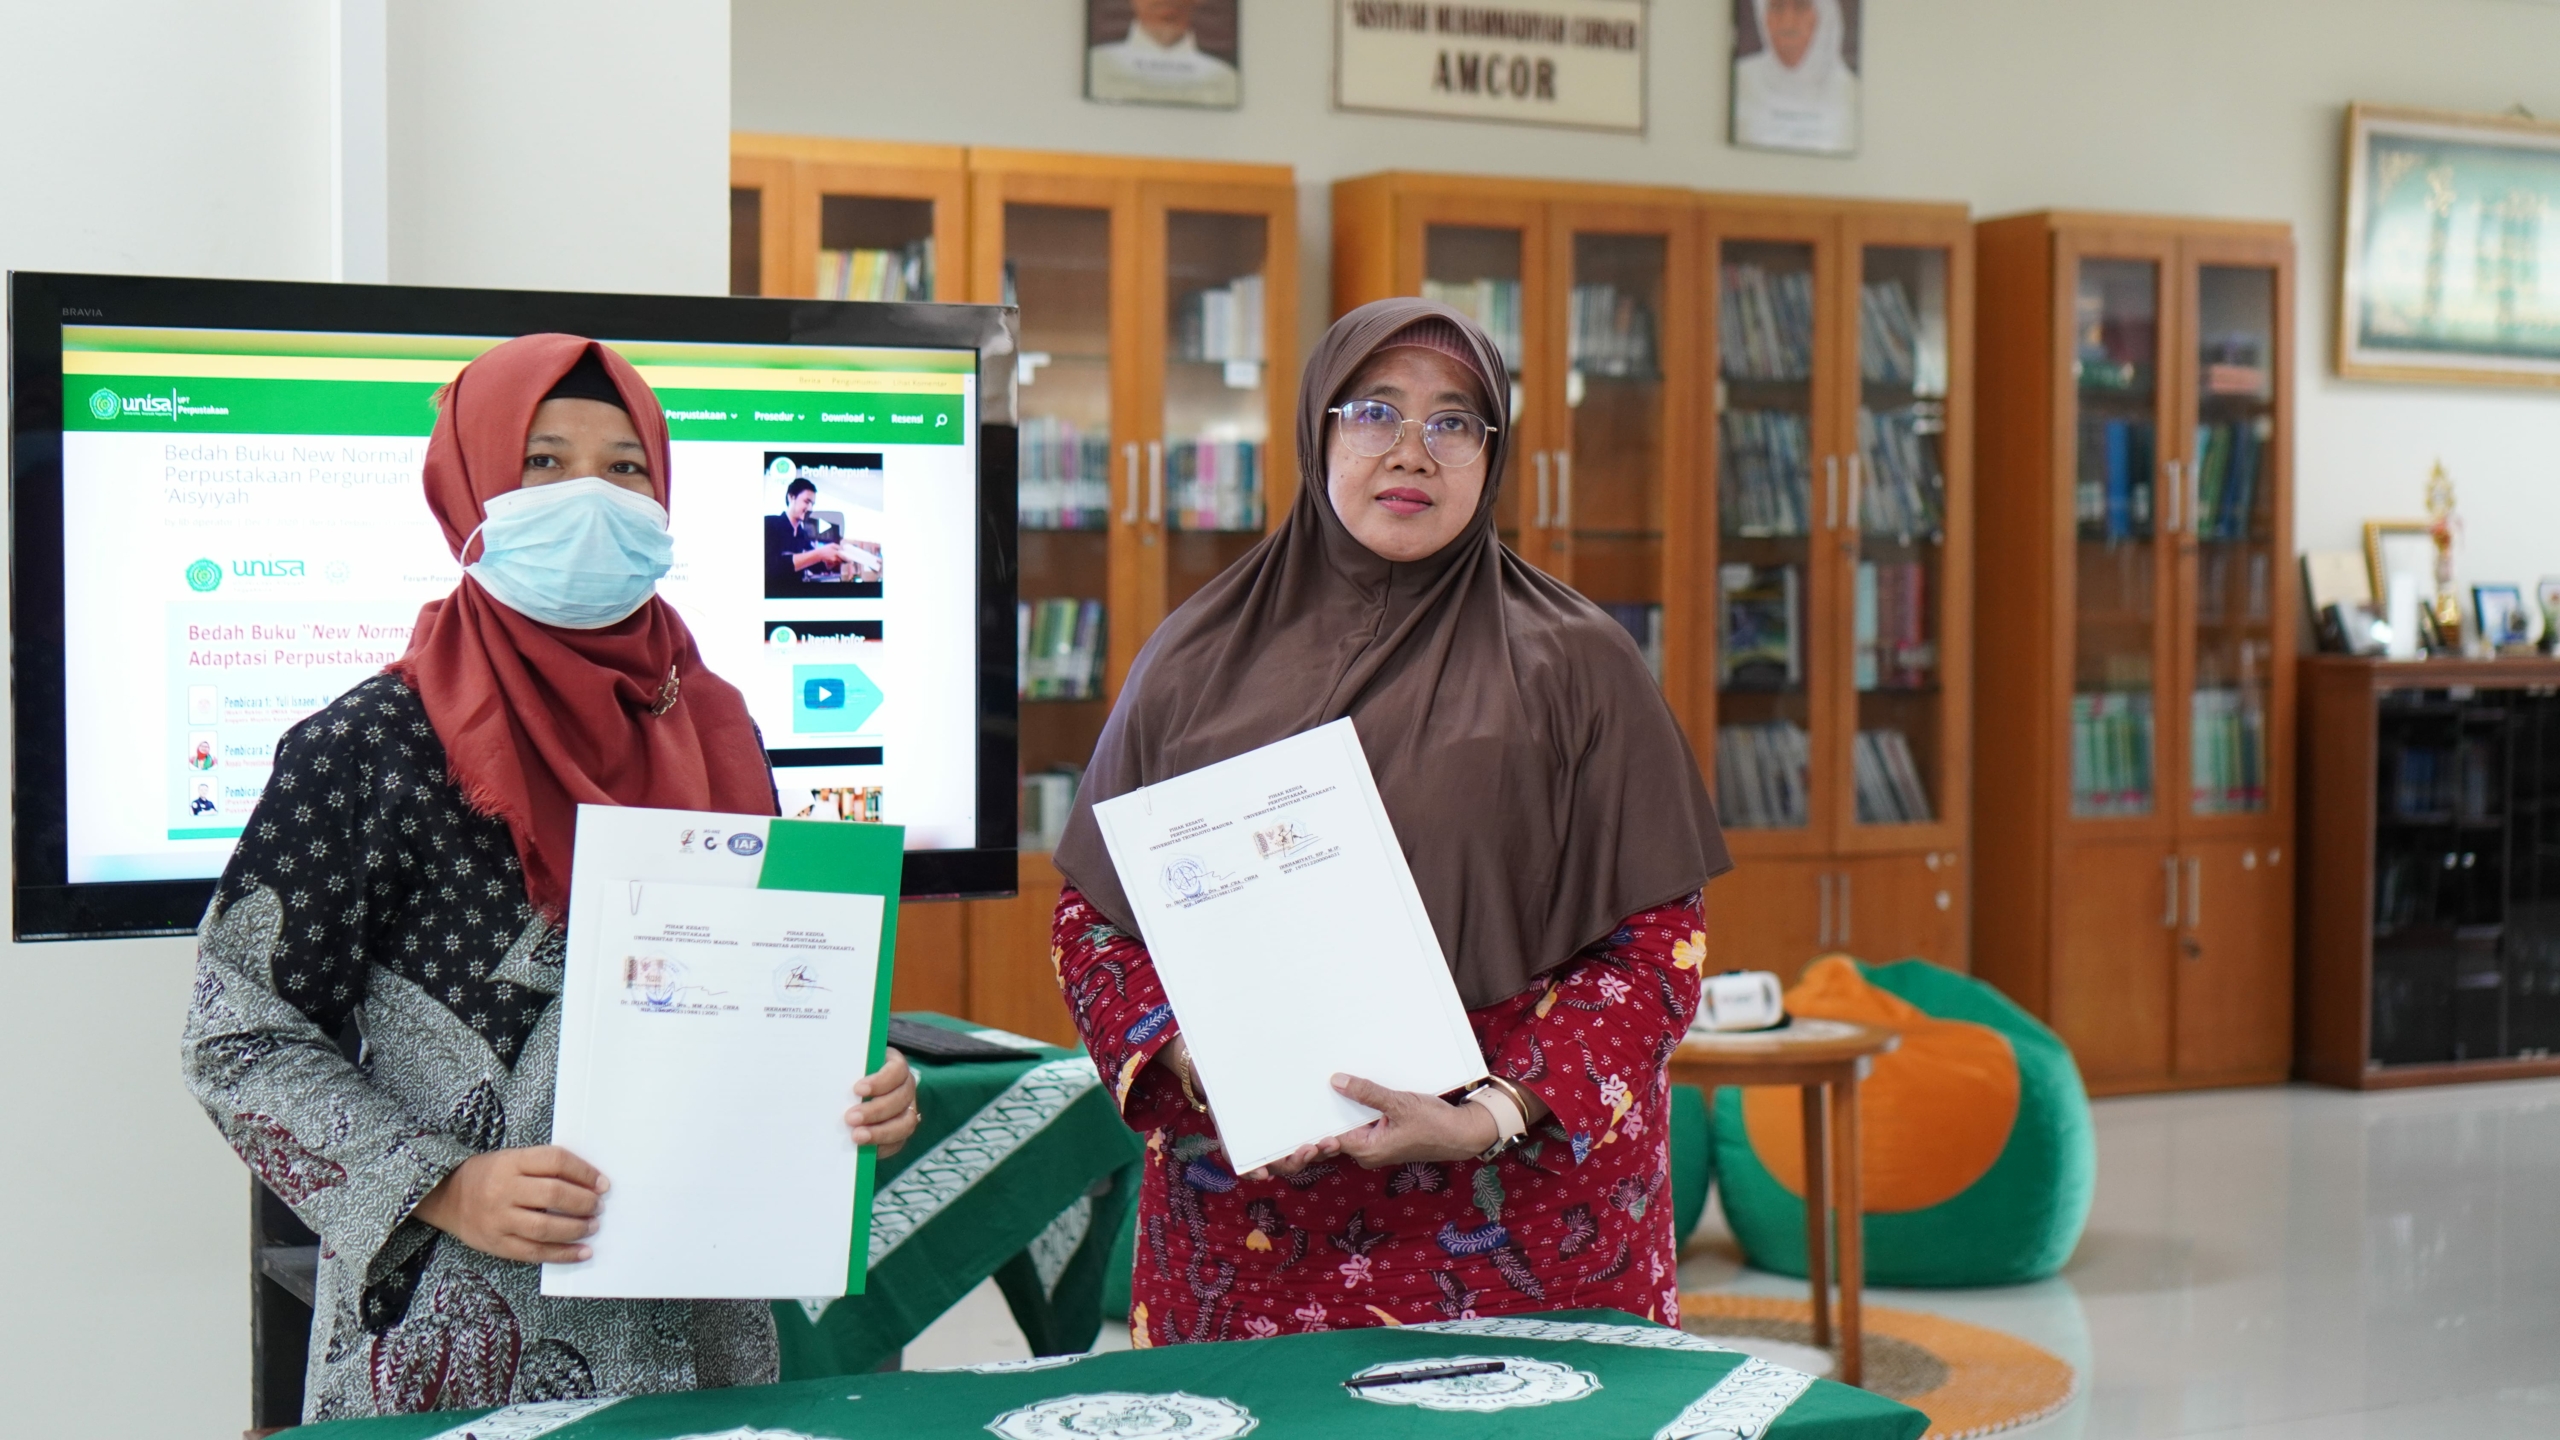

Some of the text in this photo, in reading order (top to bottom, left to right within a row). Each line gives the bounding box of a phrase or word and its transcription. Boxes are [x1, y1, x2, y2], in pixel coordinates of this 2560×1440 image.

[1432, 49, 1557, 101] AMCOR
[62, 306, 104, 318] BRAVIA
[122, 393, 173, 412] unisa
[177, 405, 229, 416] Perpustakaan
[665, 409, 924, 424] Perpustakaan Prosedur Download Resensi
[165, 445, 413, 464] Bedah Buku New Normal
[165, 466, 410, 488] Perpustakaan Perguruan
[801, 465, 828, 477] Profil
[231, 557, 306, 577] unisa
[188, 624, 244, 641] Bedah
[252, 625, 296, 641] Buku
[188, 649, 396, 670] Adaptasi Perpustakaan
[224, 696, 263, 708] Pembicara
[225, 744, 263, 756] Pembicara
[734, 838, 758, 849] IAF
